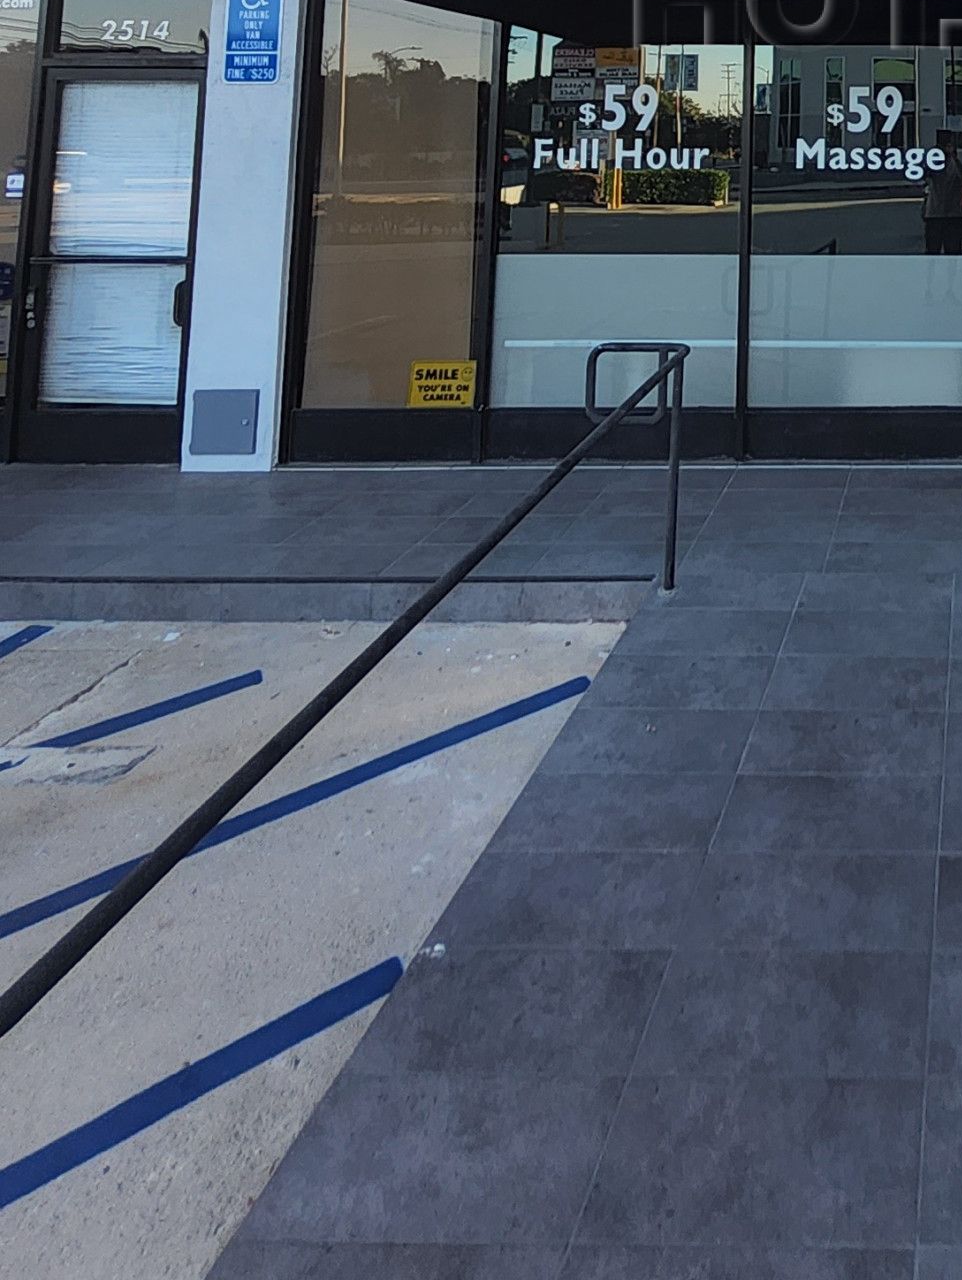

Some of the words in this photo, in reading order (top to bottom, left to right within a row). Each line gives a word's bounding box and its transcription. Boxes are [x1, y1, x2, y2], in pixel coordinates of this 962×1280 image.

[238, 10, 270, 20] PARKING
[100, 19, 170, 41] 2514
[244, 21, 264, 30] ONLY
[246, 31, 261, 40] VAN
[231, 41, 274, 50] ACCESSIBLE
[233, 55, 270, 67] MINIMUM
[227, 68, 245, 79] FINE
[250, 68, 275, 80] $250
[578, 83, 659, 131] $59
[826, 86, 903, 133] $59
[532, 137, 600, 170] Full
[614, 137, 710, 171] Hour
[795, 138, 946, 180] Massage
[415, 368, 459, 381] SMILE
[417, 384, 452, 393] YOU'RE
[455, 384, 469, 392] ON
[423, 393, 461, 401] CAMERA
